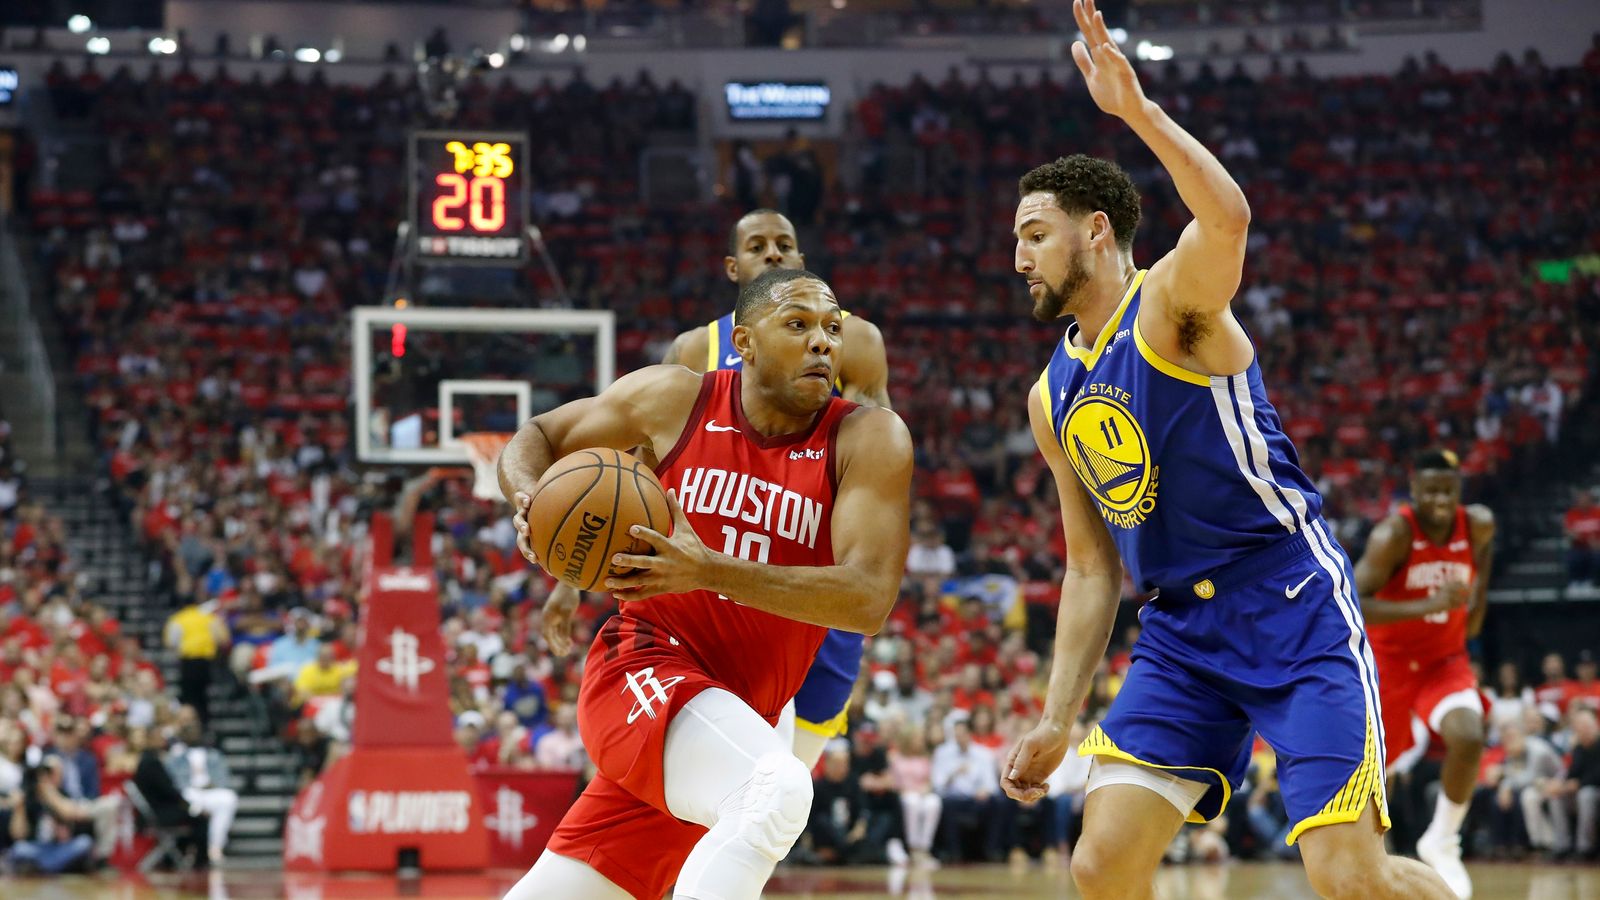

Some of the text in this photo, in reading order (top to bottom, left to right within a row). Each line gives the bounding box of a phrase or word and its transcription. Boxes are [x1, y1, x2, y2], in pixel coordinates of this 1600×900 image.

[445, 141, 513, 178] 7:35
[432, 173, 505, 231] 20
[1090, 383, 1132, 404] STATE
[1100, 416, 1123, 449] 11
[678, 467, 823, 549] HOUSTON
[1098, 465, 1159, 529] WARRIORS
